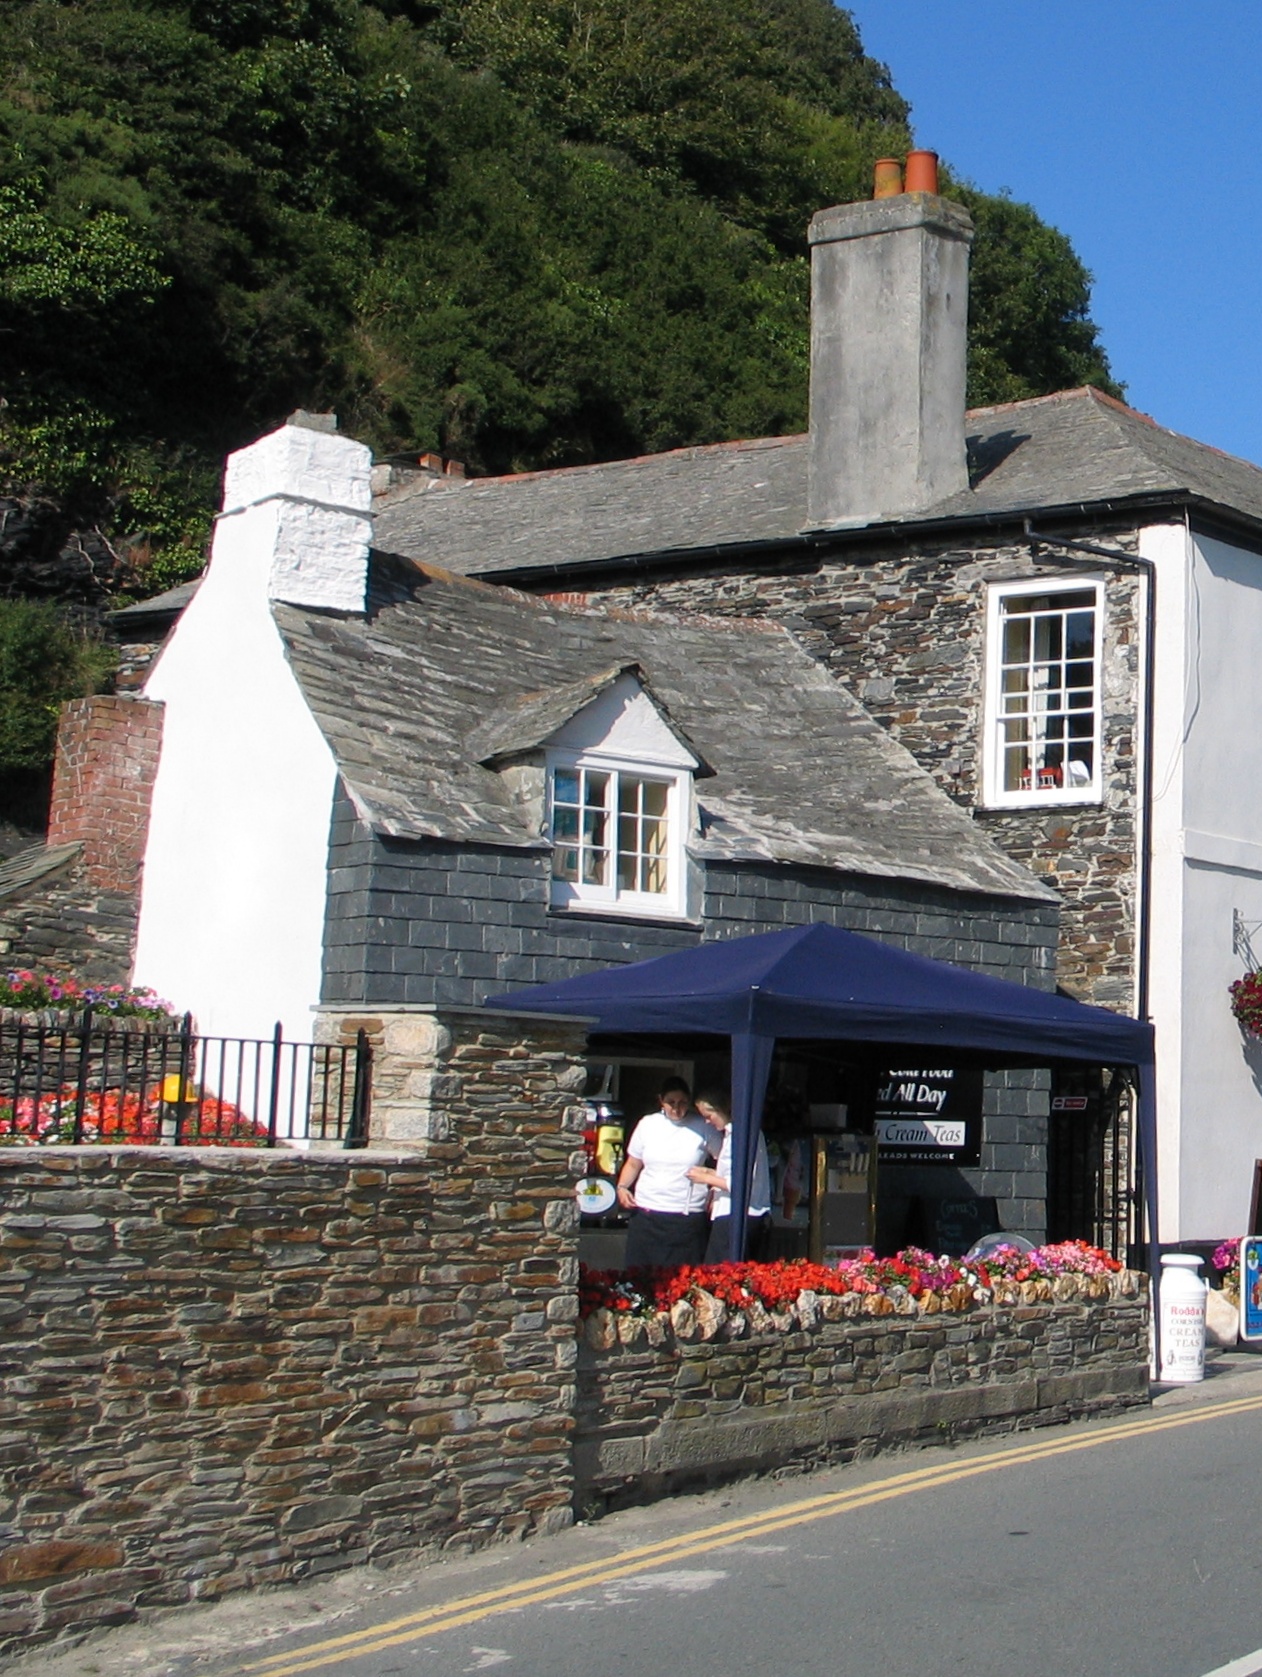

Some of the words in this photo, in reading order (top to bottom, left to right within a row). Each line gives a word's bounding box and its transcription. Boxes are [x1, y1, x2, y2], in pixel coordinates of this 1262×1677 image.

[892, 1082, 916, 1102] All
[916, 1084, 947, 1111] Day
[885, 1124, 927, 1142] Cream
[934, 1125, 961, 1142] Teas
[909, 1152, 955, 1160] WELCOME
[1175, 1339, 1200, 1348] TEAS
